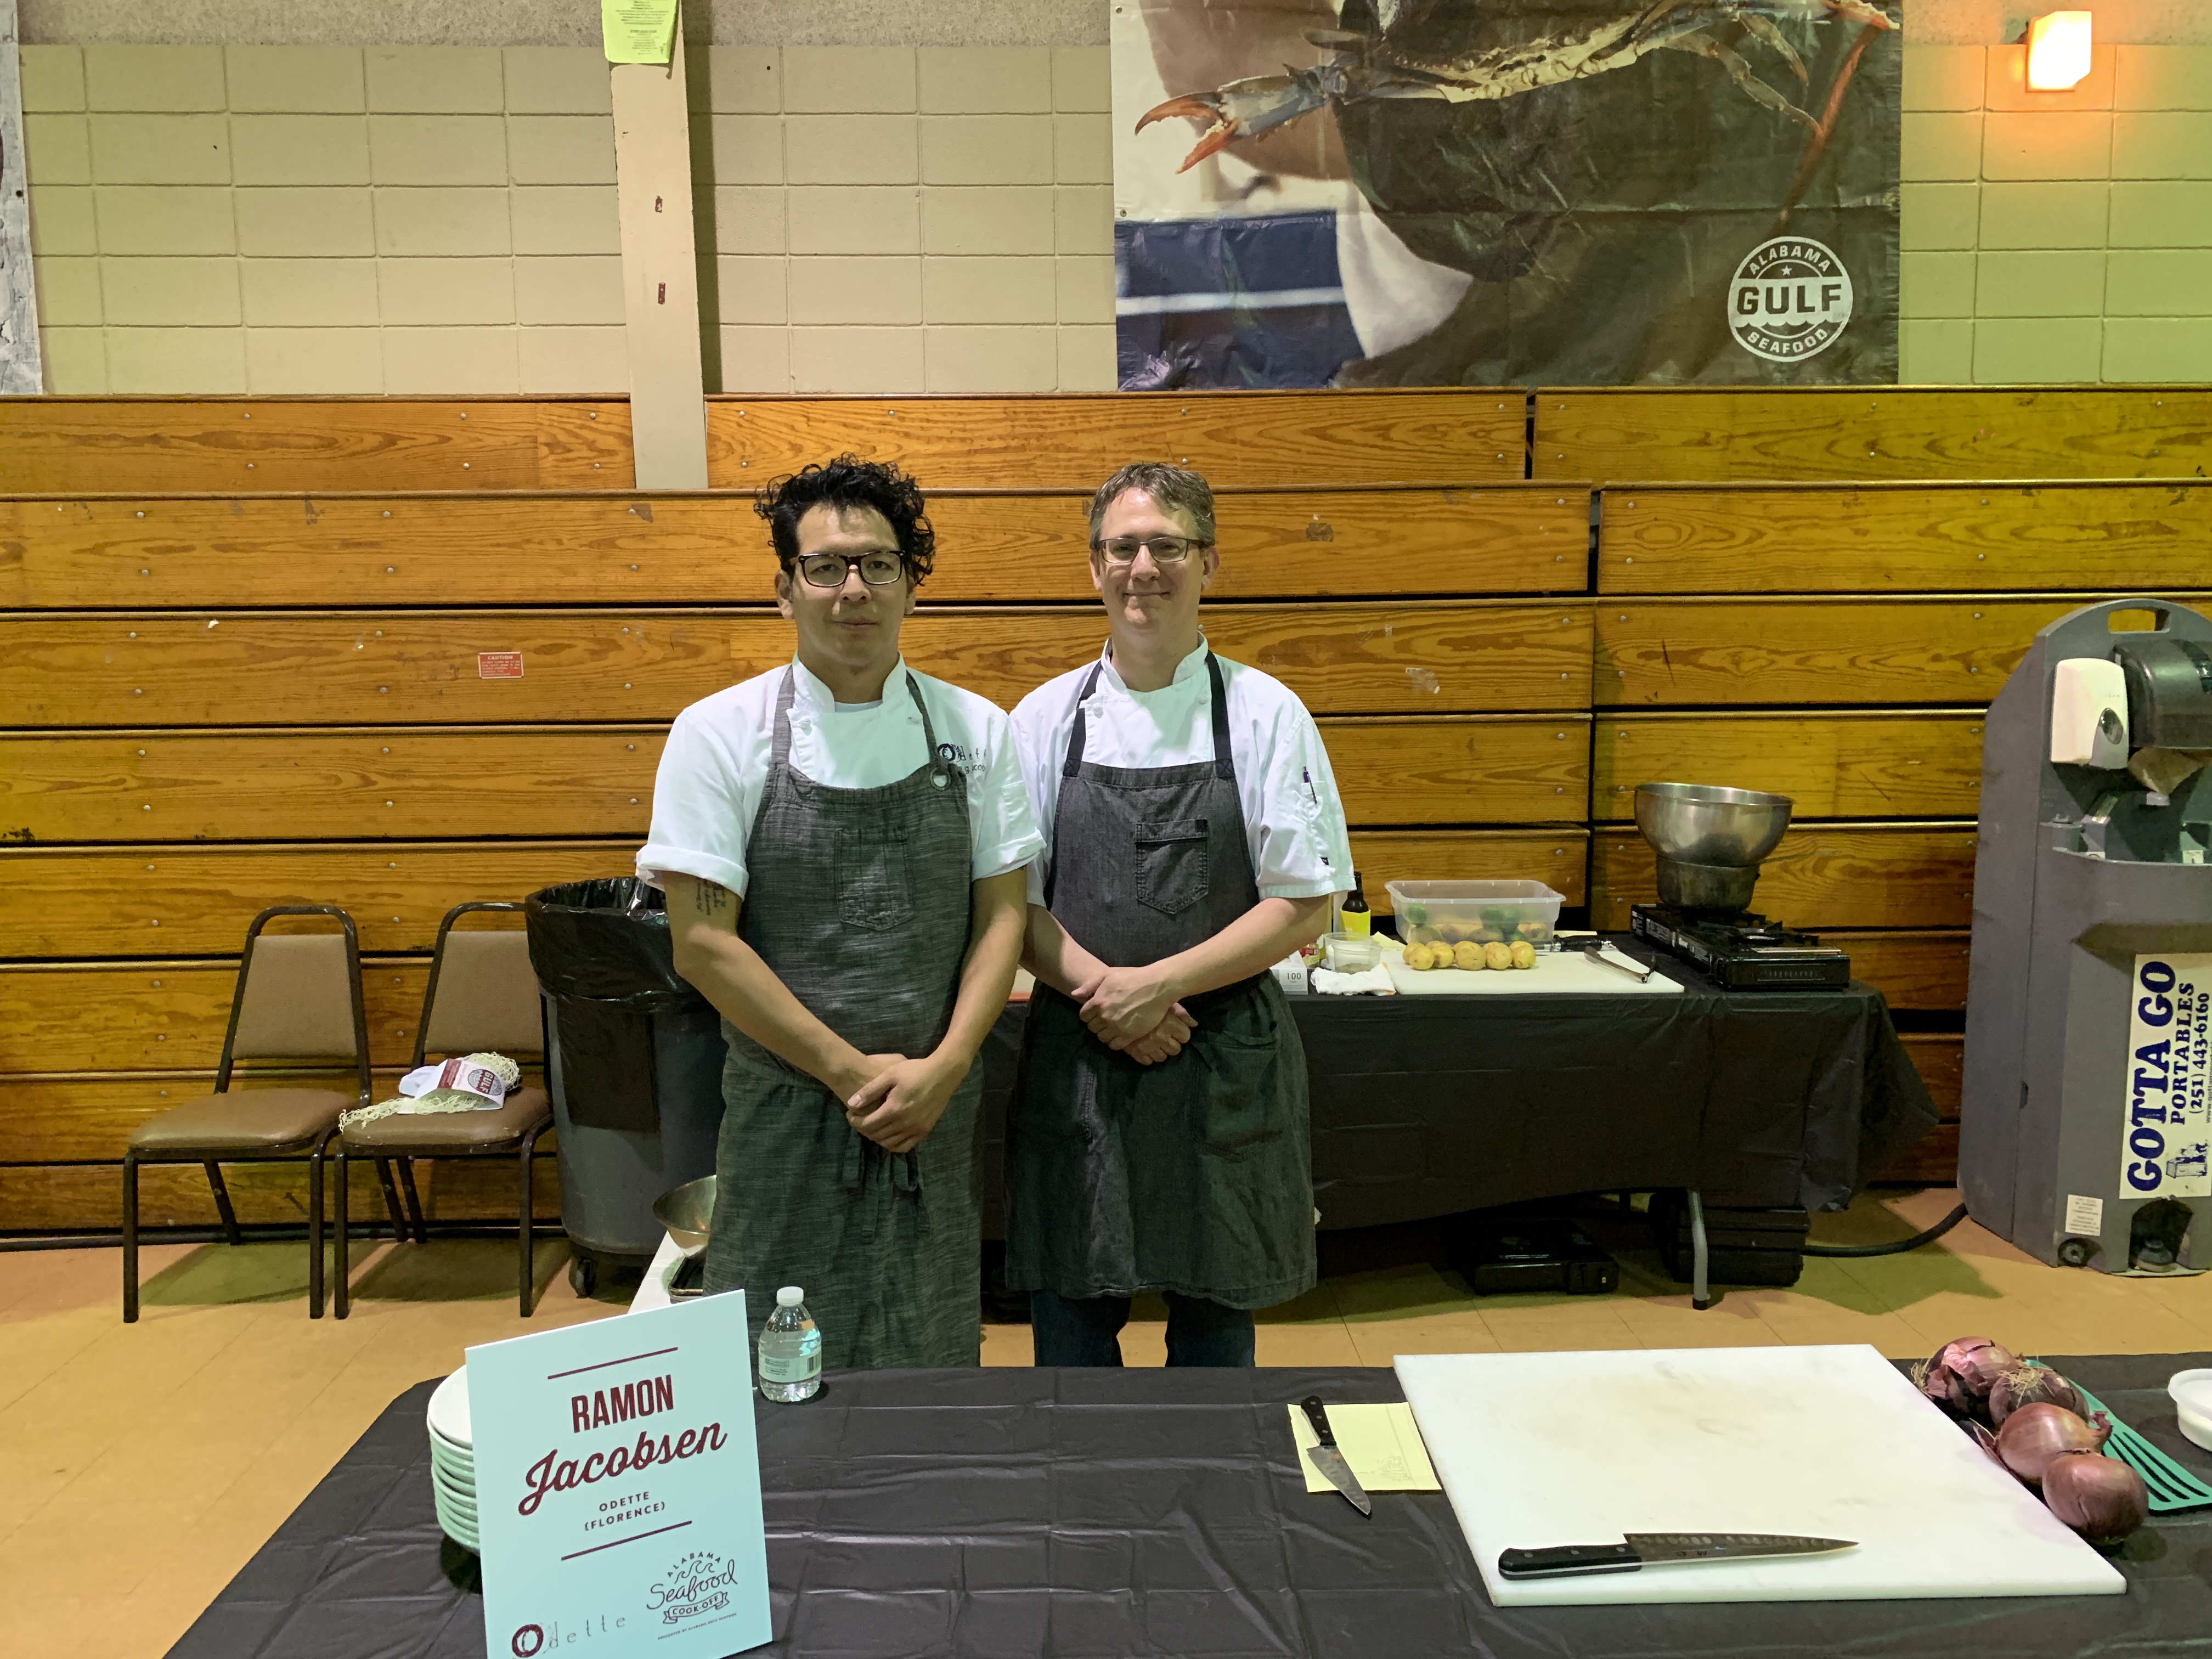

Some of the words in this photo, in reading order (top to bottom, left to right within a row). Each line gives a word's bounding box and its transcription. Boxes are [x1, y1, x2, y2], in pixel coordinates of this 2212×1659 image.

[1748, 245, 1831, 274] ALABAMA
[1736, 284, 1842, 315] GULF
[1747, 328, 1829, 354] SEAFOOD
[2137, 961, 2176, 1027] GO
[2192, 993, 2210, 1069] 443-6160
[2170, 983, 2194, 1125] PORTABLES
[481, 1071, 494, 1093] GULF
[2189, 1074, 2207, 1114] (251)
[2127, 1039, 2171, 1191] GOTTA
[572, 1374, 674, 1433] RAMON
[518, 1422, 728, 1516] Jacobsen
[584, 1501, 665, 1531] (FLORENCE)
[599, 1491, 650, 1512] ODETTE
[646, 1559, 738, 1610] Seafood
[667, 1551, 720, 1578] ALABAMA
[672, 1595, 719, 1615] COOK-OFF
[512, 1615, 625, 1658] Odette
